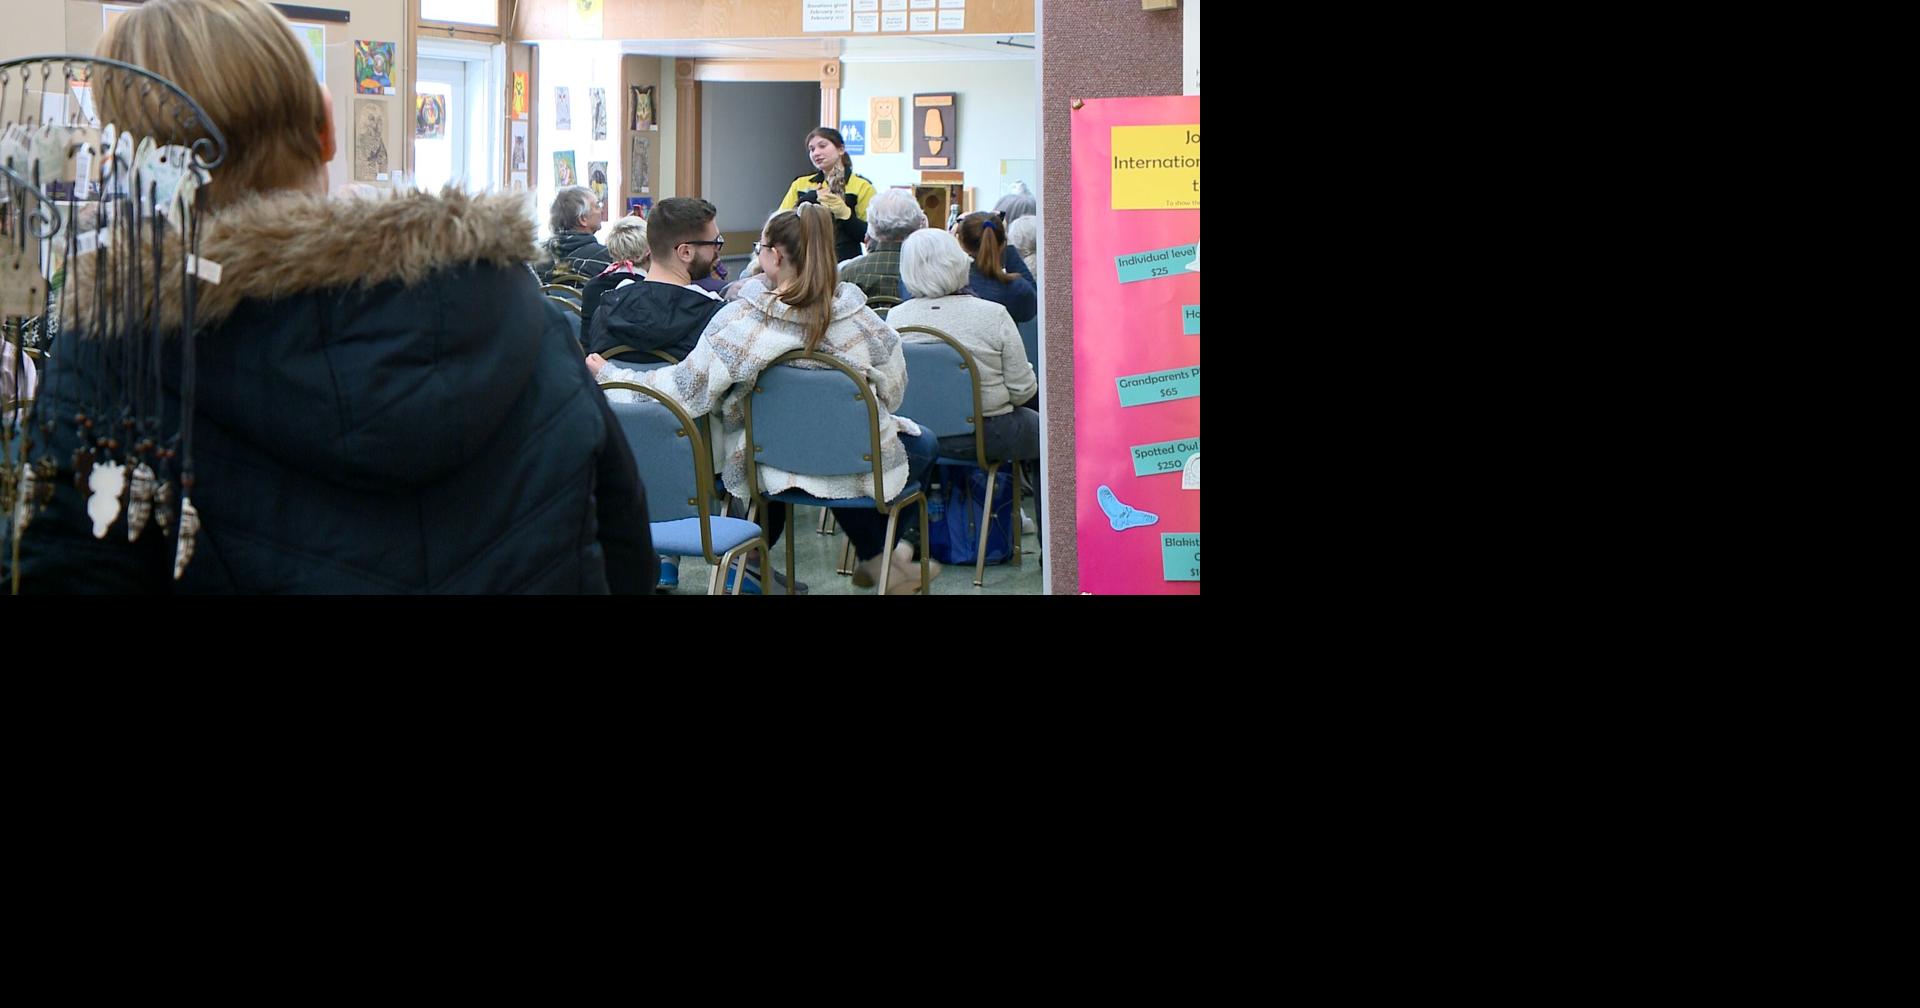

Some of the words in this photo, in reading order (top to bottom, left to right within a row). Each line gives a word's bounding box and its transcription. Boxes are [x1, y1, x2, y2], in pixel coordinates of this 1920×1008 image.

[1118, 251, 1169, 267] Individual
[1171, 246, 1197, 259] level
[1151, 266, 1169, 277] $25
[1119, 371, 1190, 388] Grandparents
[1159, 387, 1178, 397] $65
[1135, 444, 1175, 459] Spotted
[1177, 441, 1198, 453] Owl
[1157, 460, 1182, 470] $250
[1165, 537, 1200, 547] Blakist
[1190, 568, 1200, 577] $1
